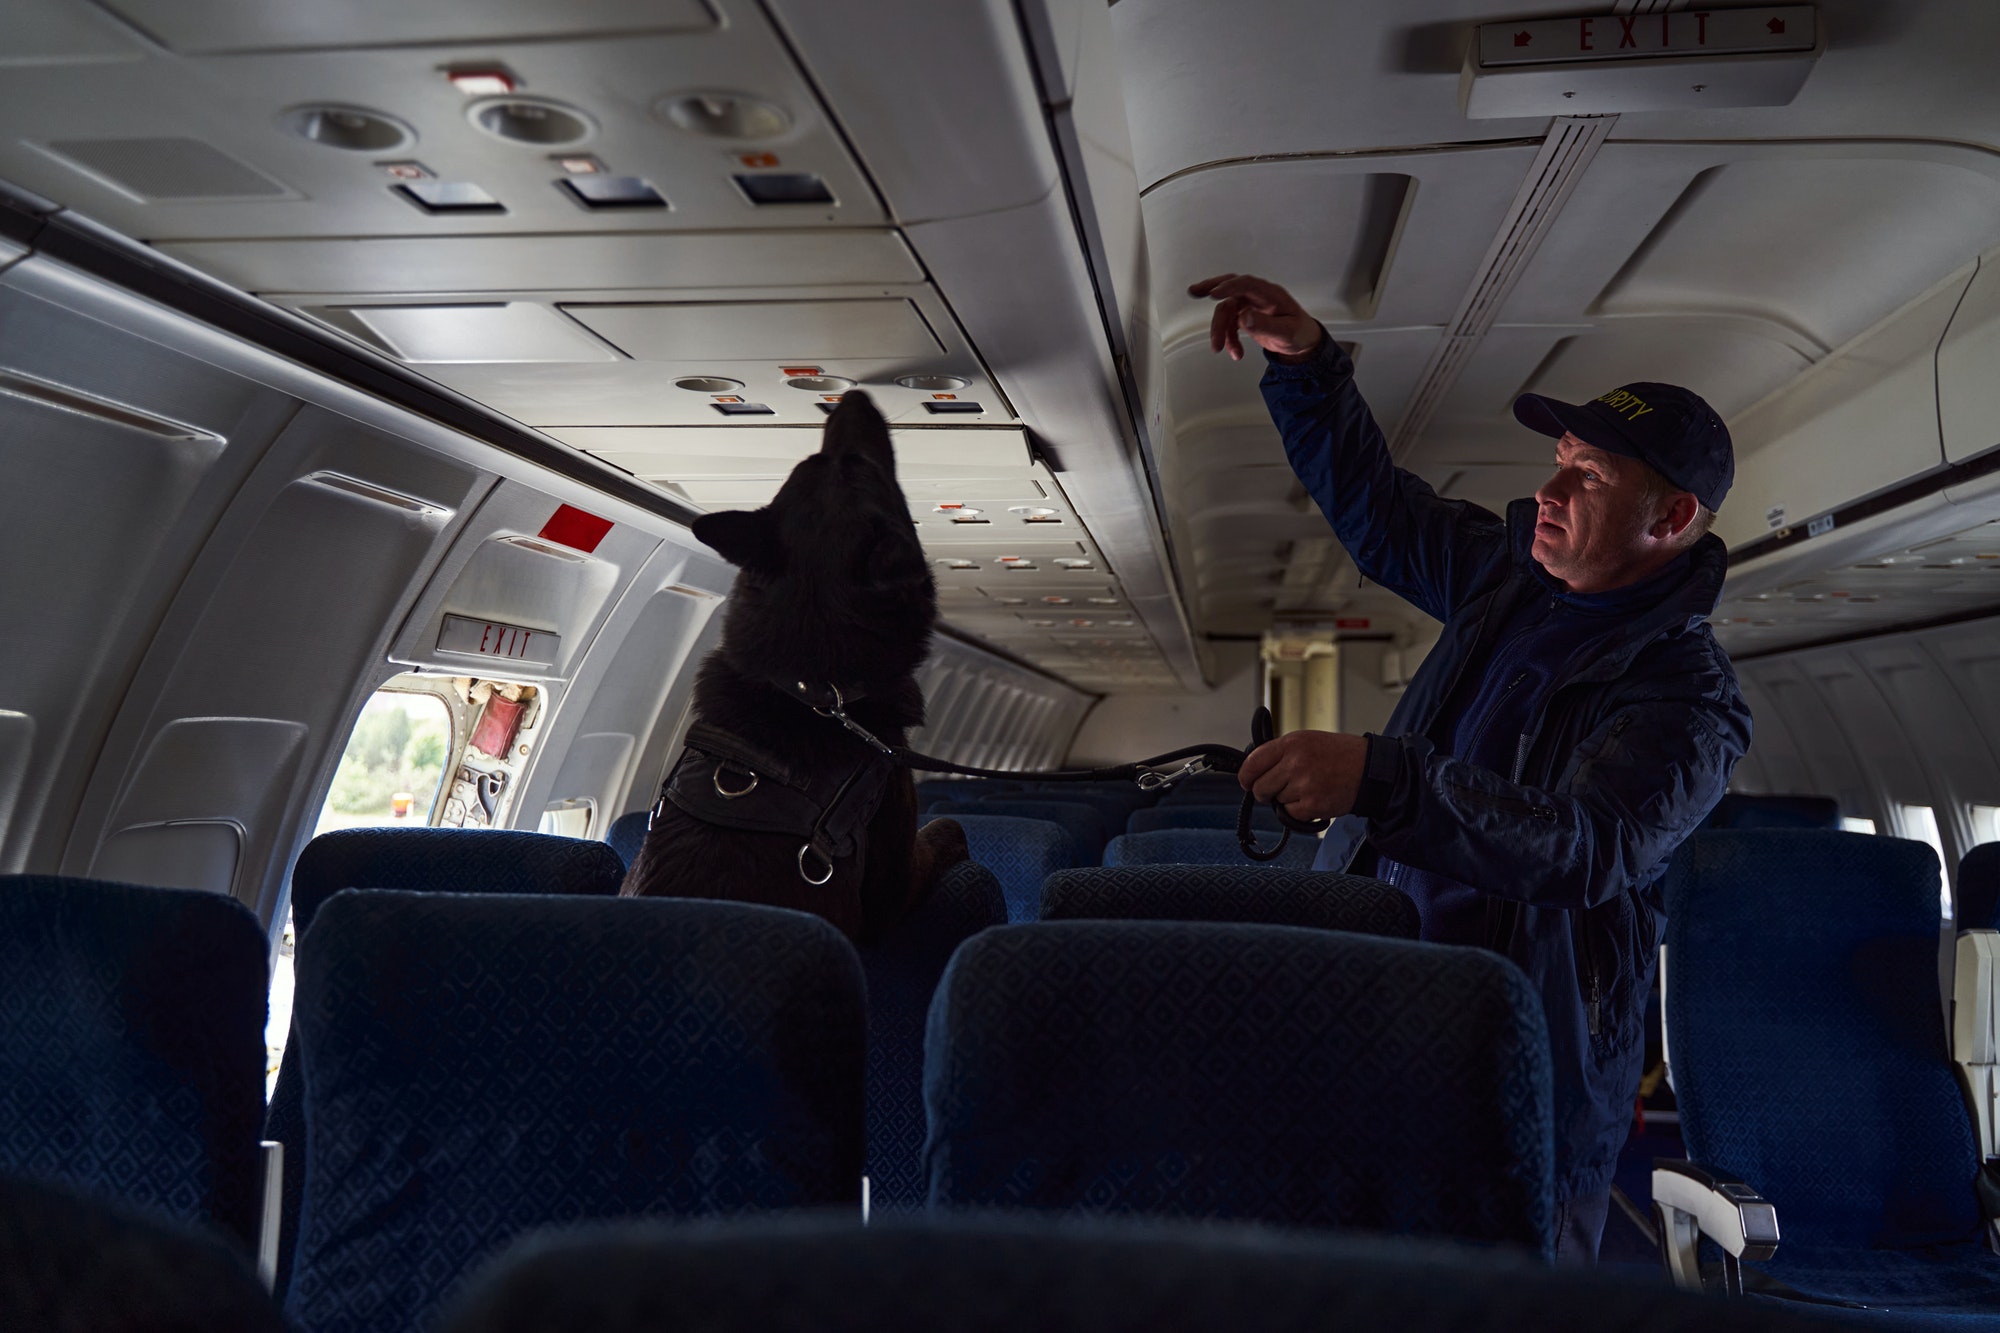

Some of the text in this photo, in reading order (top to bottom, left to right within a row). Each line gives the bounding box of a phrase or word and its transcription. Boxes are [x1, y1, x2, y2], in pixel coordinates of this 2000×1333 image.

[1580, 13, 1710, 50] EXIT
[1597, 389, 1653, 420] URITY
[480, 625, 531, 657] EXIT
